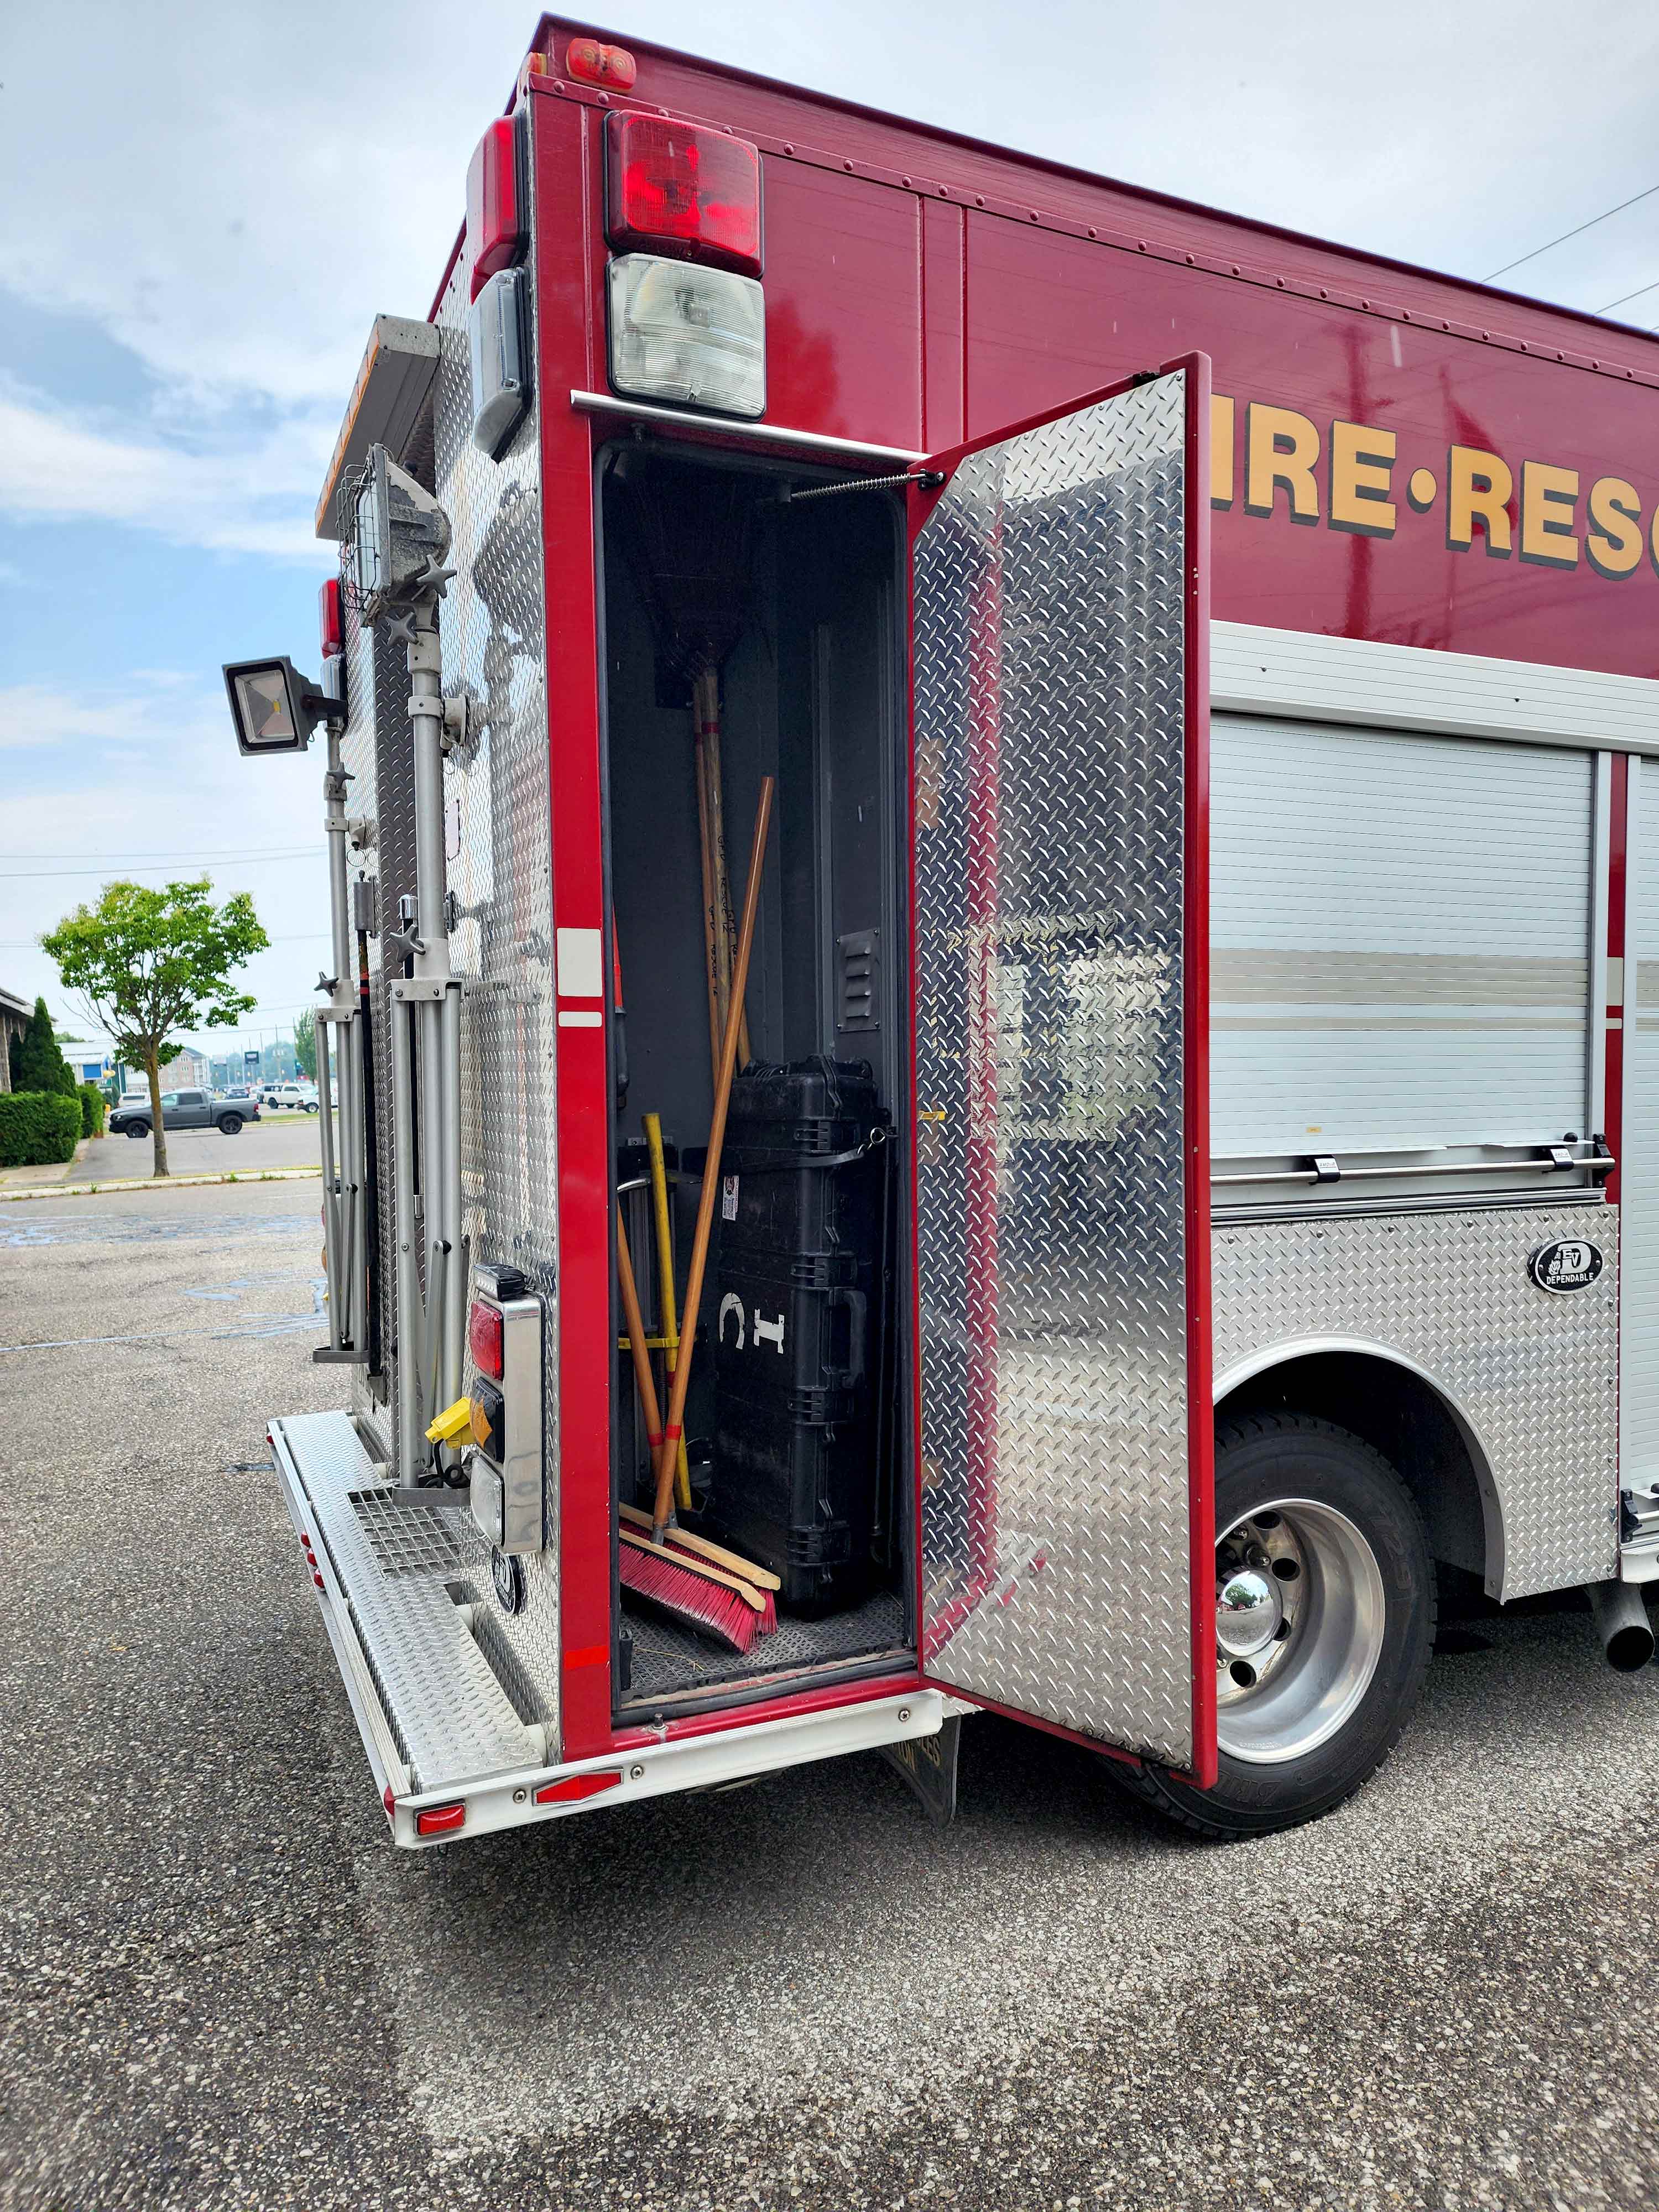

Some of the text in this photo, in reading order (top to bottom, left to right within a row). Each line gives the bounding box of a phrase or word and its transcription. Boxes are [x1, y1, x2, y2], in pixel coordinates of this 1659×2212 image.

[1211, 393, 1659, 581] IRE RES
[1546, 1272, 1594, 1285] DEPENDABLE
